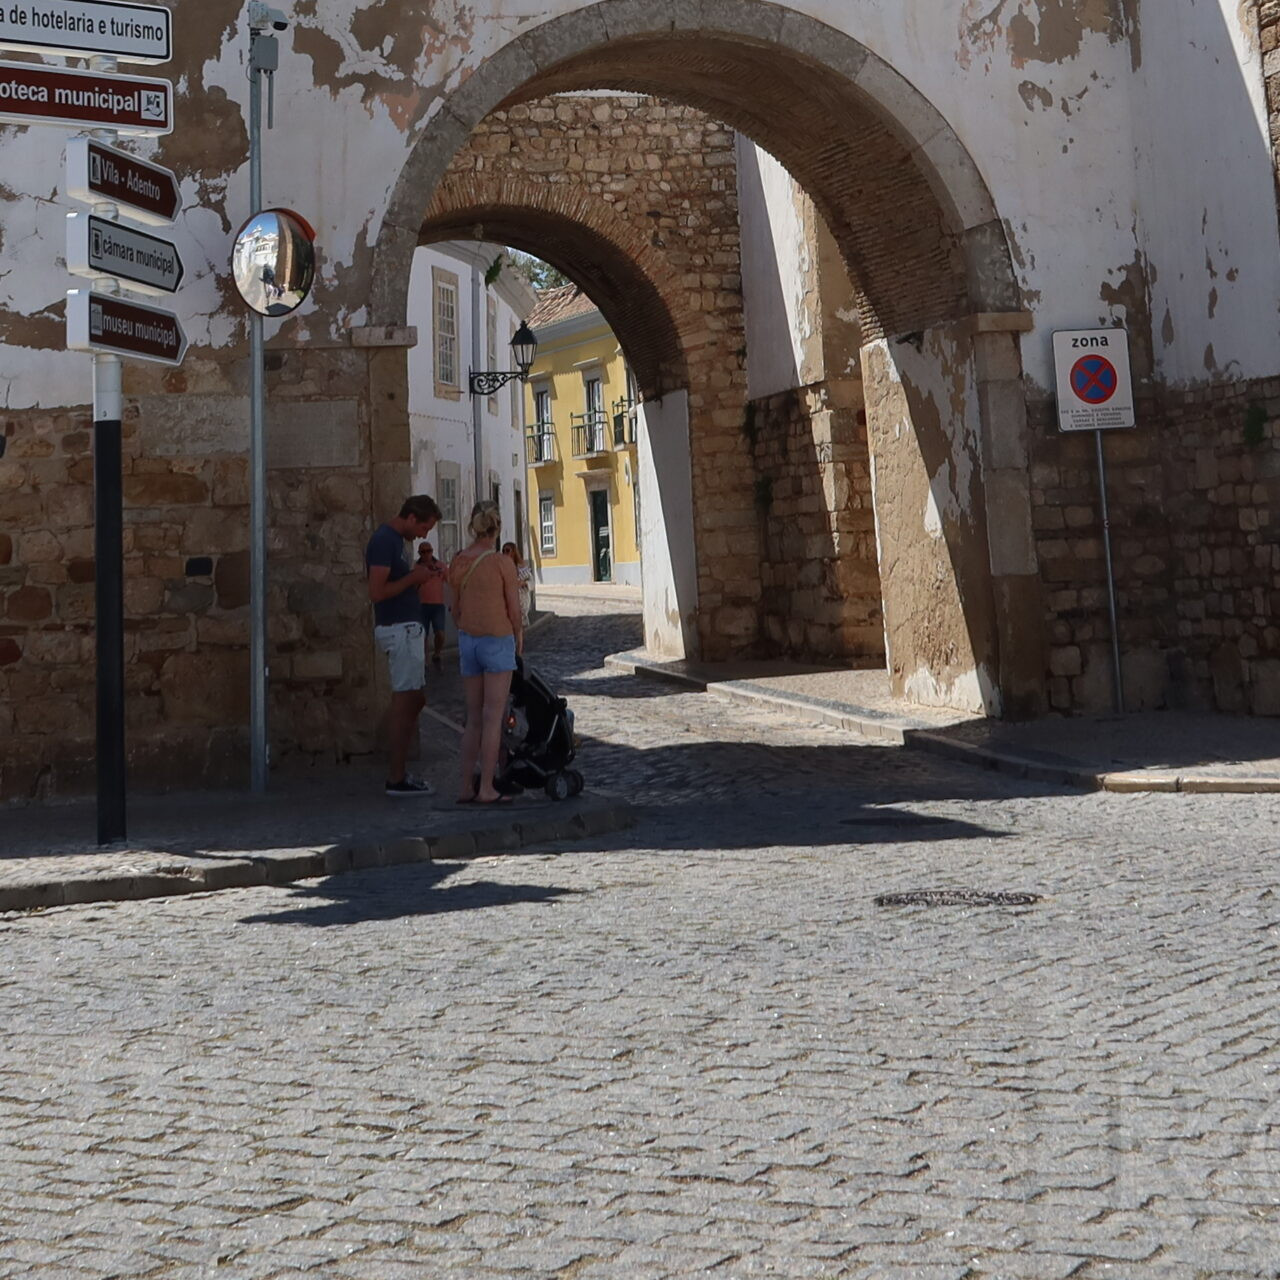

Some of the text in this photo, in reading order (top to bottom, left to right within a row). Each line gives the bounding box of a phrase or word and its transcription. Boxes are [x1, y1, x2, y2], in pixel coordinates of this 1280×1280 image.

[9, 4, 27, 26] de
[32, 7, 95, 34] hotelaria
[98, 20, 107, 34] e
[111, 17, 164, 42] turismo
[54, 86, 139, 115] municipal
[101, 158, 120, 185] Vila
[126, 169, 161, 201] Adentro
[102, 234, 175, 277] câmara municipal
[103, 315, 176, 349] museu municipal
[1071, 336, 1109, 348] zona
